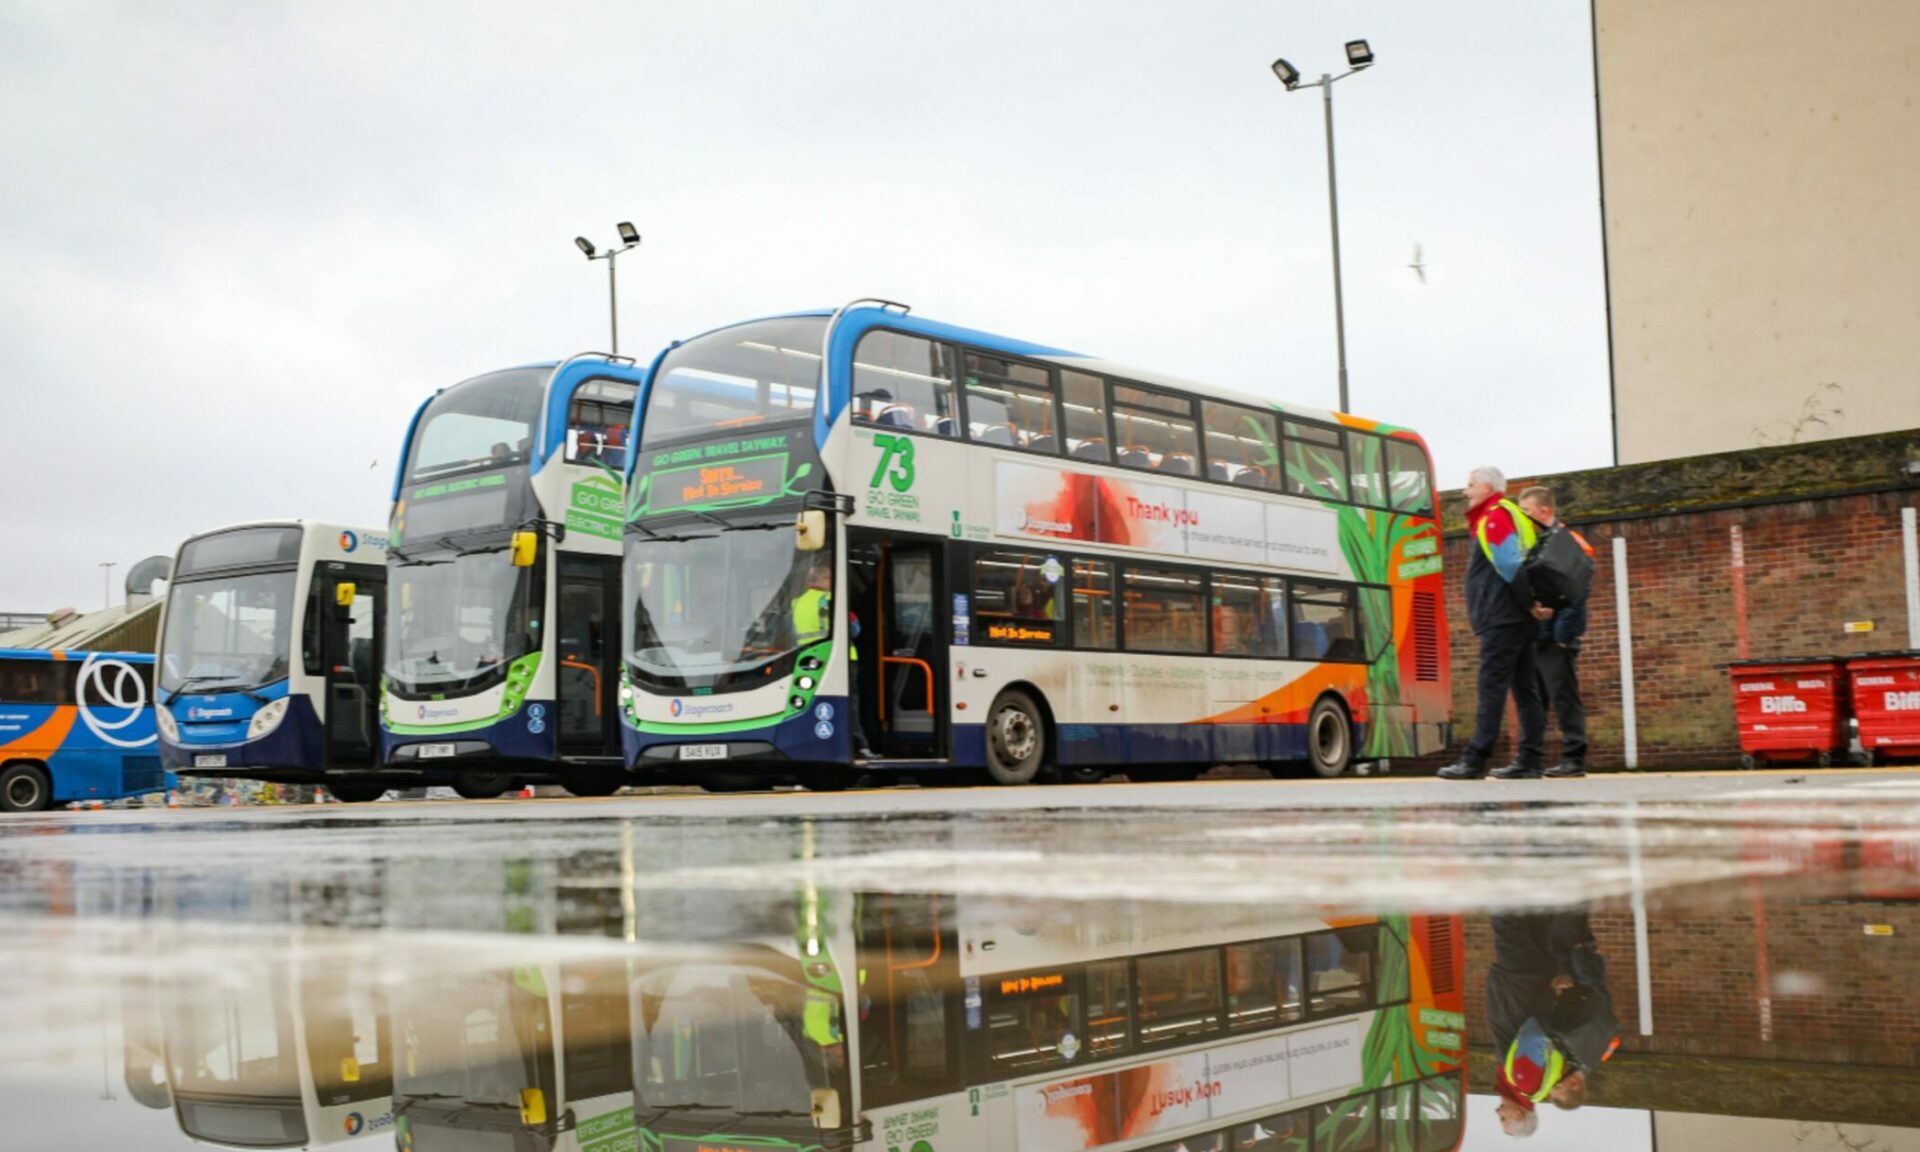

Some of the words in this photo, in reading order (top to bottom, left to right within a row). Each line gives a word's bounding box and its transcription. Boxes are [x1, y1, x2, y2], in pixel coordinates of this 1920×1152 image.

[652, 453, 669, 466] GO
[704, 442, 739, 457] TRAVEL
[869, 433, 915, 492] 73
[577, 491, 599, 507] GO
[683, 486, 704, 501] Not
[720, 480, 763, 496] Service
[867, 489, 884, 505] GO
[1126, 496, 1170, 522] Thank
[1173, 505, 1198, 527] you
[1760, 695, 1807, 714] Biffa
